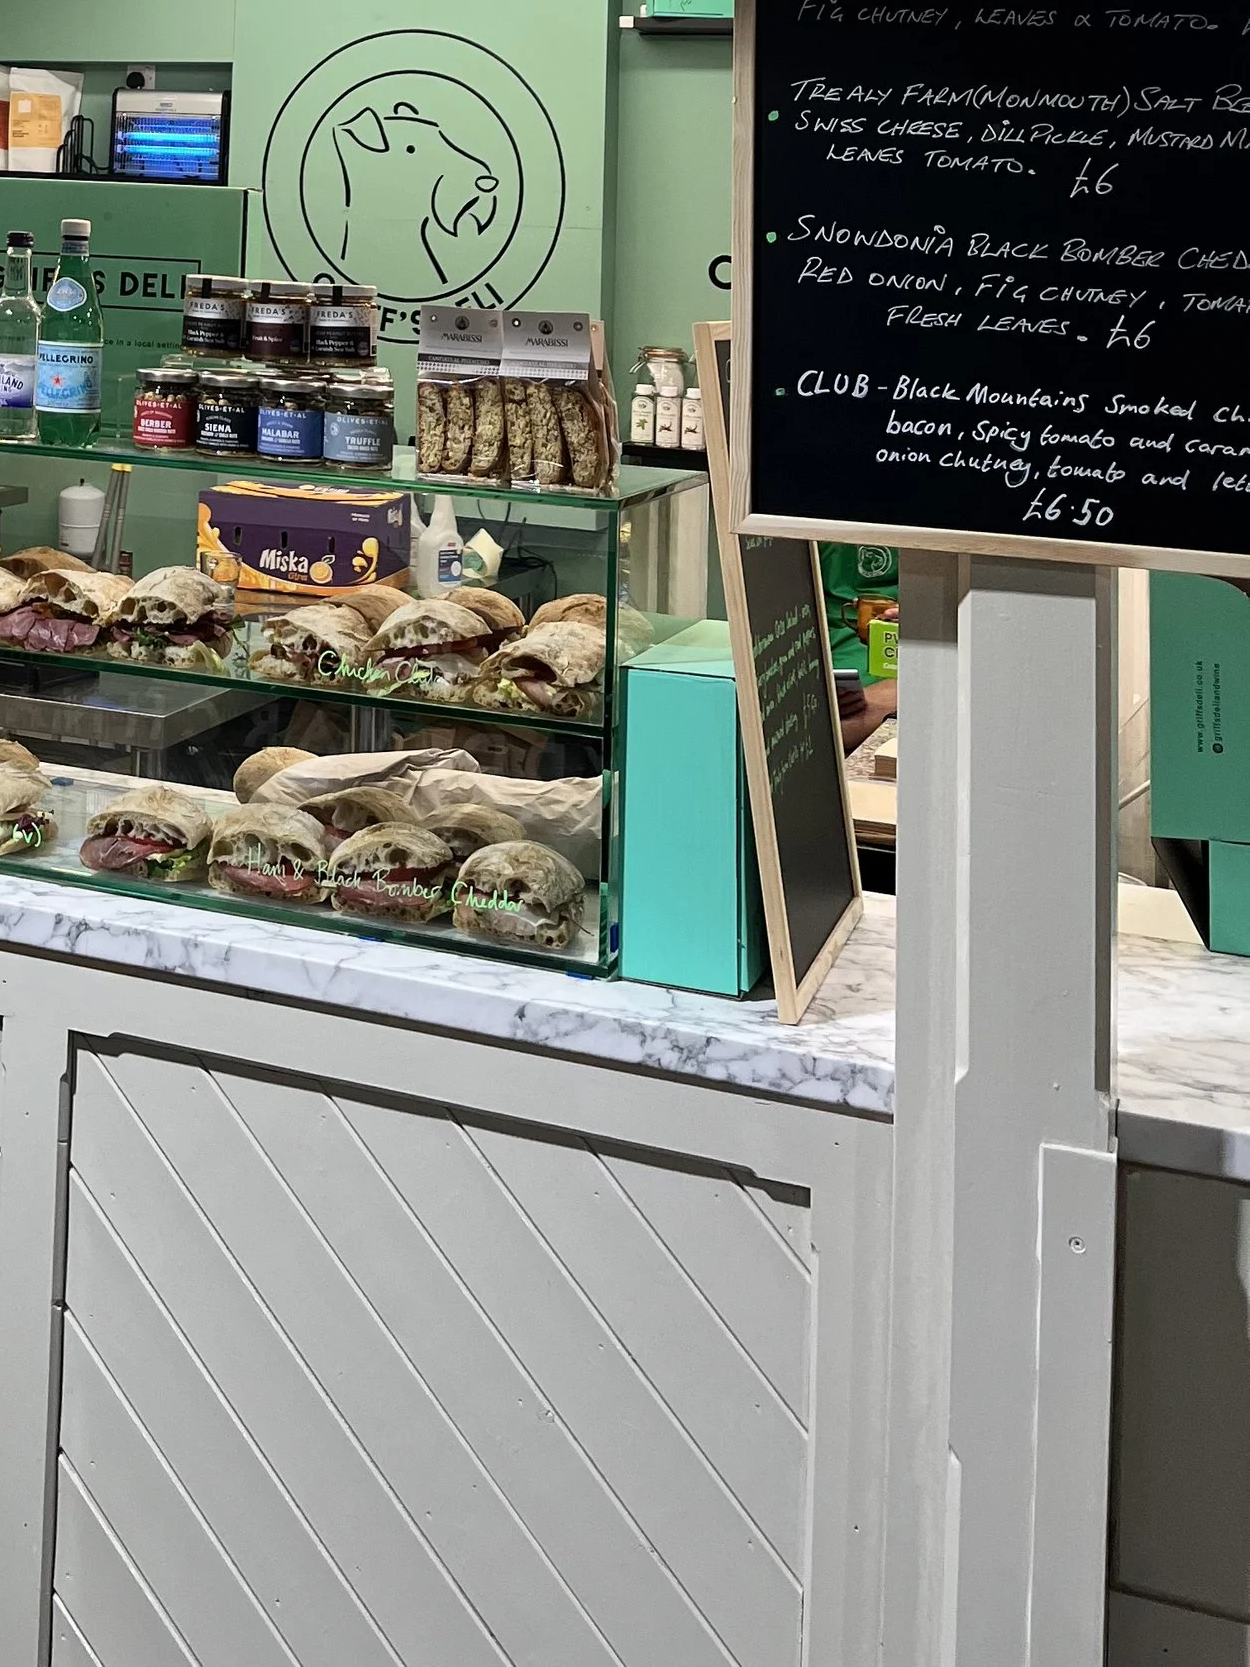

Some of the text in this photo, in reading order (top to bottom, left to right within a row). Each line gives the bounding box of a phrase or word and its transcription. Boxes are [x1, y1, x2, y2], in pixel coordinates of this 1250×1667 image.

[974, 8, 1057, 26] LEAVES
[1133, 87, 1202, 113] SALT
[795, 111, 864, 133] SWISS
[1127, 128, 1213, 150] MUSTARD
[826, 146, 903, 164] LEAVES
[1070, 158, 1119, 198] £6
[966, 234, 1048, 260] BLACK
[1060, 239, 1173, 268] BOMBER
[1177, 247, 1250, 269] CHED
[797, 256, 853, 285] RED
[190, 302, 225, 311] FREDA'S
[252, 307, 285, 315] FREDA'S
[317, 310, 353, 318] FREDA'S
[441, 333, 482, 343] MARABISSI
[886, 305, 962, 327] FRESH
[1106, 315, 1156, 350] £6
[525, 337, 568, 347] MARABISSI
[797, 369, 870, 398] CLUB
[966, 382, 1086, 413] Mountains
[1104, 395, 1194, 421] Smoked
[141, 419, 172, 428] BERBER
[205, 423, 231, 432] SIENA
[972, 420, 1031, 451] Spicy
[1040, 422, 1115, 449] tomato
[1130, 430, 1172, 452] and
[345, 436, 380, 446] TRUFFLE
[875, 446, 931, 464] onion
[1048, 454, 1126, 483] tomato
[1141, 472, 1187, 491] and
[259, 549, 309, 573] Miska
[248, 843, 524, 912] Ham & Black Bomber Cheddar
